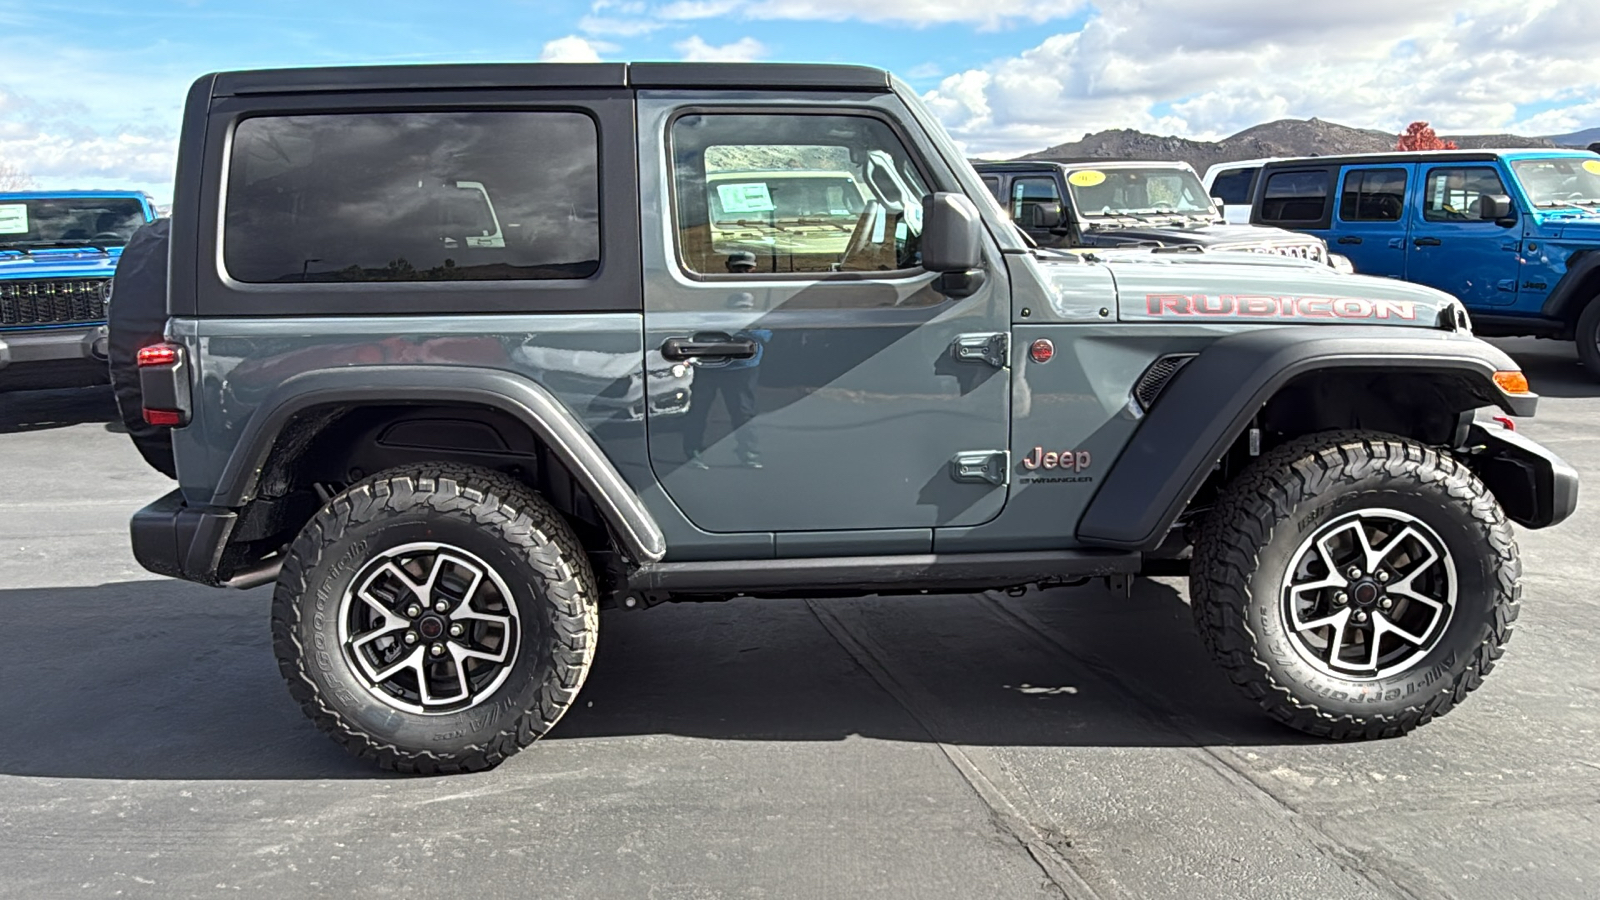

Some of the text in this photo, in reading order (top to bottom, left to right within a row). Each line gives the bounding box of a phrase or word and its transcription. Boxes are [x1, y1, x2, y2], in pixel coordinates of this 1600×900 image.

[1146, 294, 1417, 320] RUBICON
[1023, 446, 1091, 473] Jeep
[1031, 476, 1093, 484] WRANGLER
